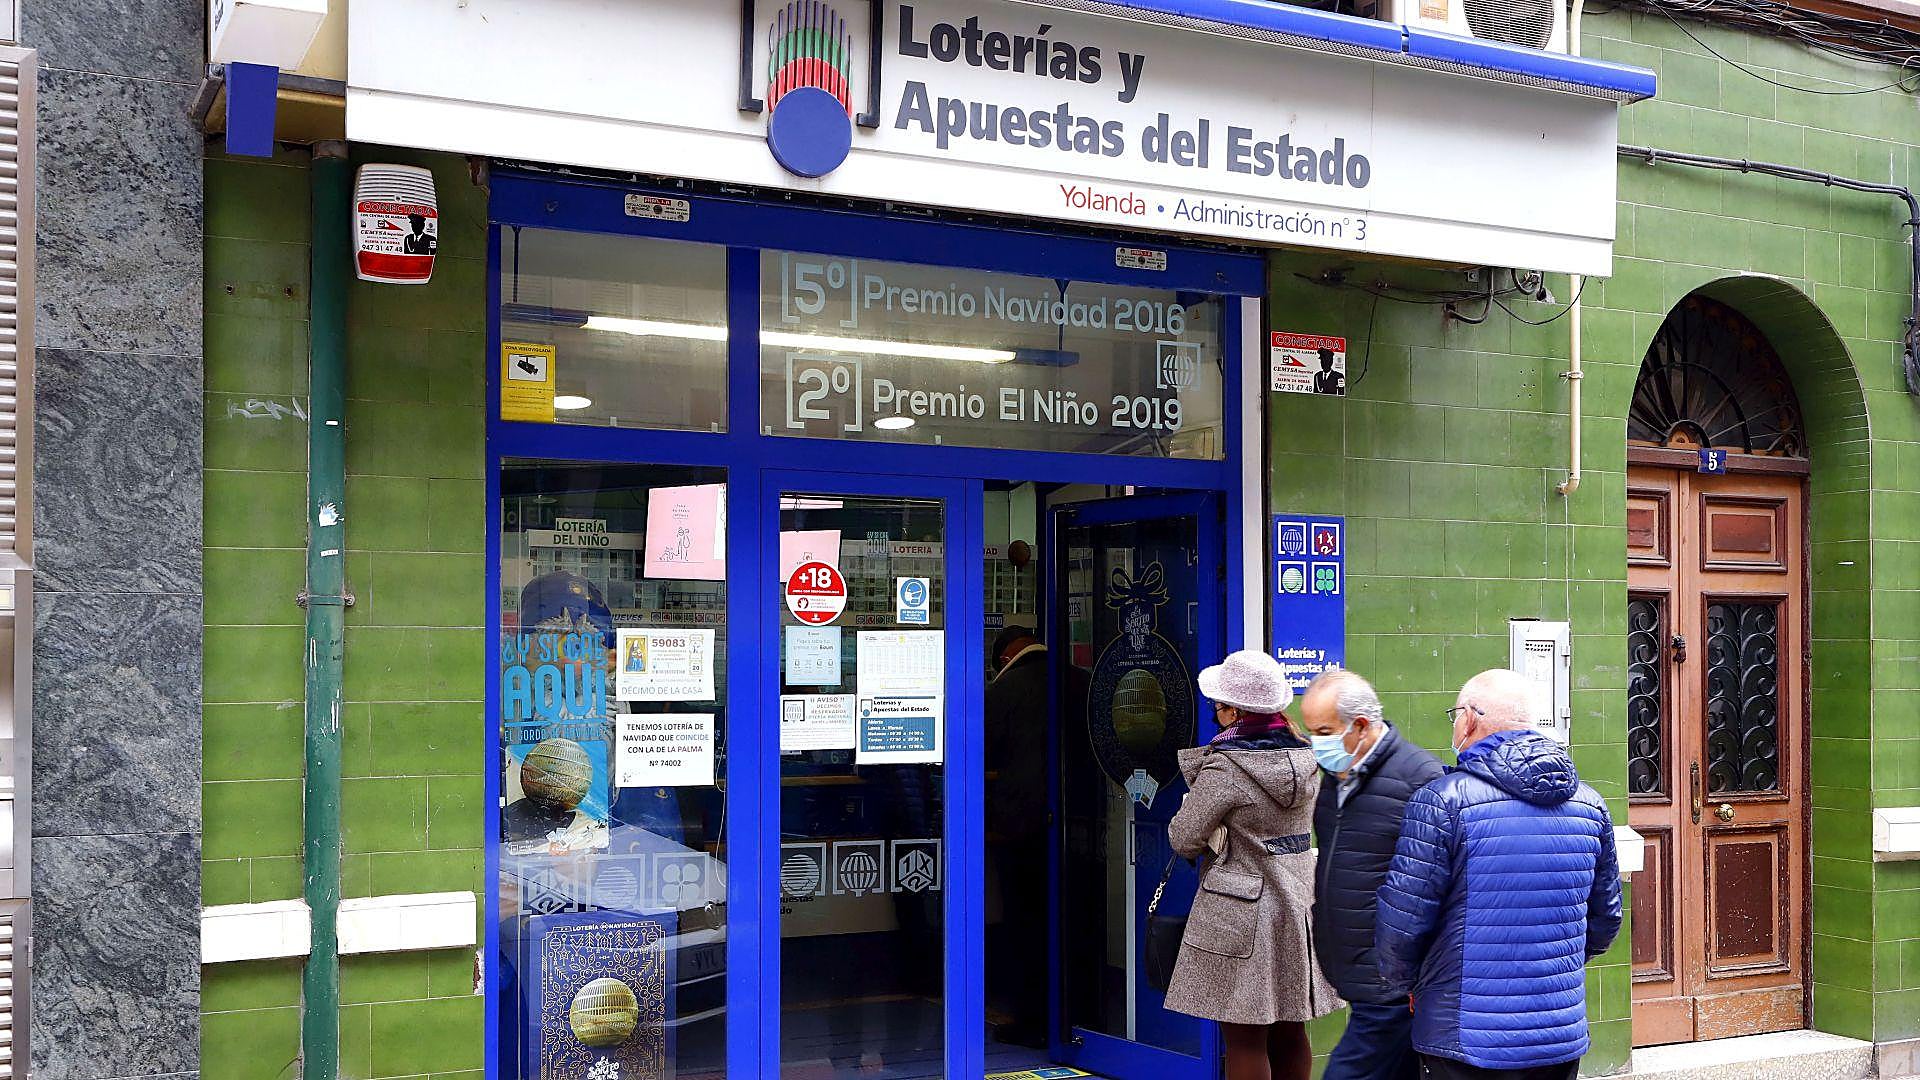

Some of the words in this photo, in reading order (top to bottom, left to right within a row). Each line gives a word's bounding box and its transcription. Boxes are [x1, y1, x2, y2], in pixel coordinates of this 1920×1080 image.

[899, 4, 1102, 84] Loterías
[1118, 51, 1146, 103] y
[894, 80, 1125, 157] Apuestas
[1141, 113, 1209, 168] del
[1227, 126, 1370, 188] Estado
[364, 202, 433, 216] CONECTADA
[1060, 184, 1146, 216] Yolanda
[1173, 198, 1325, 235] Administración
[1355, 219, 1366, 240] 3
[864, 275, 976, 319] Premio
[984, 286, 1107, 329] Navidad
[1114, 298, 1186, 335] 2016
[1275, 335, 1341, 350] CONECTADA
[1274, 382, 1285, 391] 947
[1287, 383, 1294, 391] 31
[873, 378, 985, 419] Premio
[1000, 387, 1025, 421] El
[1033, 389, 1099, 425] Niño
[1111, 395, 1184, 430] 2019
[1708, 451, 1718, 471] 5
[556, 519, 606, 533] LOTERÍA
[553, 534, 575, 546] DEL
[578, 533, 609, 547] NIÑO
[798, 567, 832, 588] +18
[651, 638, 686, 648] 59083
[1277, 646, 1317, 658] Loterías
[1318, 650, 1325, 661] y
[1280, 661, 1323, 676] Apuestas
[1325, 661, 1340, 672] del
[503, 660, 607, 722] AQUÍ
[621, 685, 656, 695] DÉCIMO
[670, 686, 680, 694] LA
[682, 686, 703, 694] CASA
[873, 706, 899, 714] Apuestas
[626, 723, 662, 731] TENEMOS
[663, 721, 693, 730] LOTERÍA
[622, 734, 657, 742] NAVIDAD
[658, 734, 674, 742] QUE
[675, 733, 710, 741] COINCIDE
[667, 745, 676, 753] LA
[677, 745, 703, 753] PALMA
[660, 759, 682, 767] 74002
[572, 923, 599, 932] LOTERÍA
